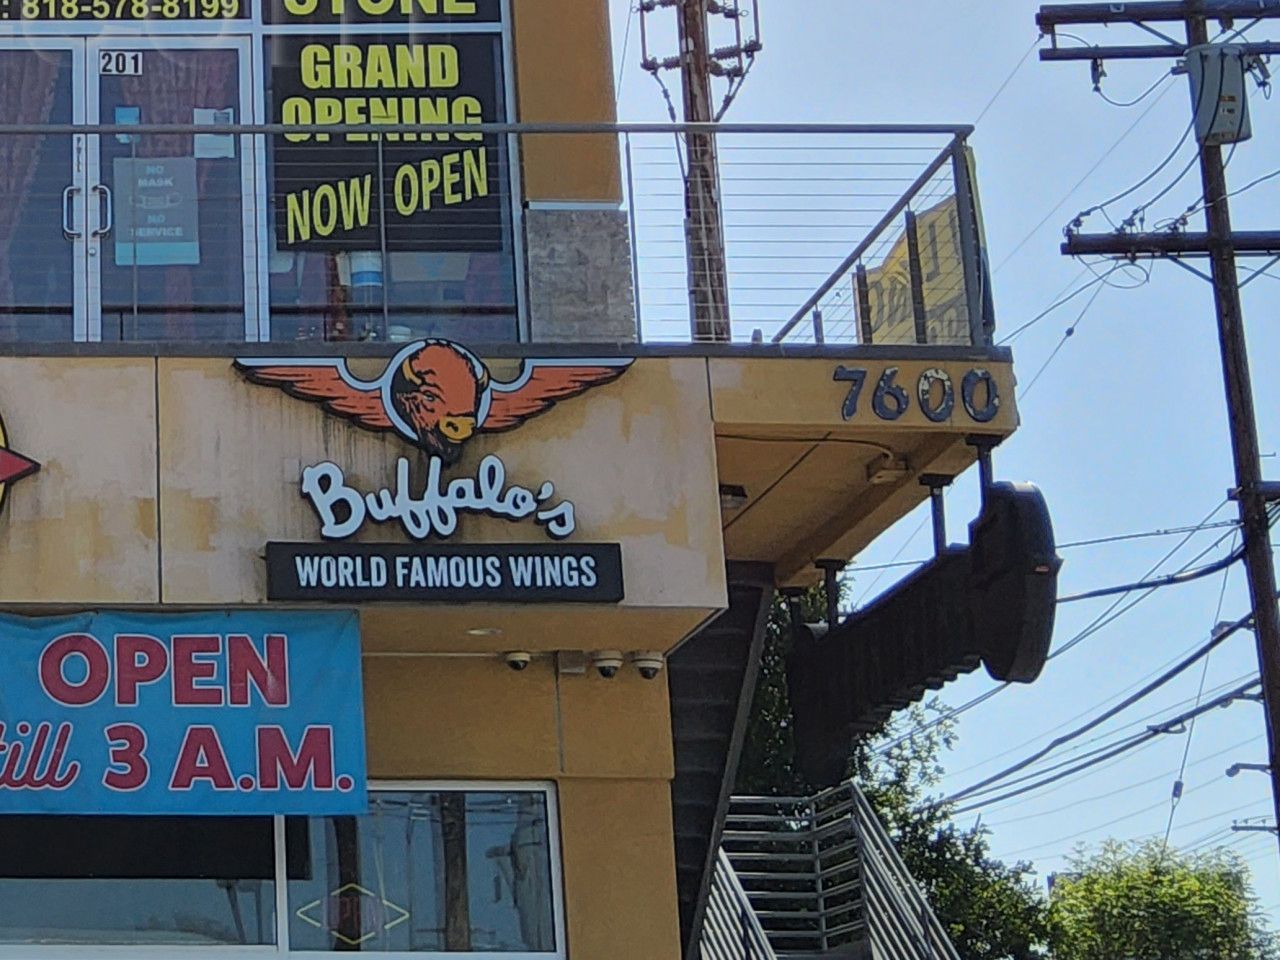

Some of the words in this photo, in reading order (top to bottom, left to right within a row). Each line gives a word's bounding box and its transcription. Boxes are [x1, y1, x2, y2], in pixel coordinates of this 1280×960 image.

[101, 51, 142, 75] 201
[300, 44, 460, 89] GRAND
[282, 96, 484, 142] OPENING
[137, 176, 174, 187] MASK
[145, 165, 165, 175] NO
[286, 173, 372, 245] NOW
[394, 146, 488, 217] OPEN
[147, 213, 166, 224] NO
[832, 365, 1000, 423] 7600
[301, 454, 576, 540] Buffalo's
[295, 556, 387, 588] WORLD
[396, 556, 501, 588] FAMOUS
[509, 556, 598, 588] WINGS
[38, 633, 290, 707] OPEN
[102, 722, 150, 791] 3
[169, 725, 354, 792] A.M.
